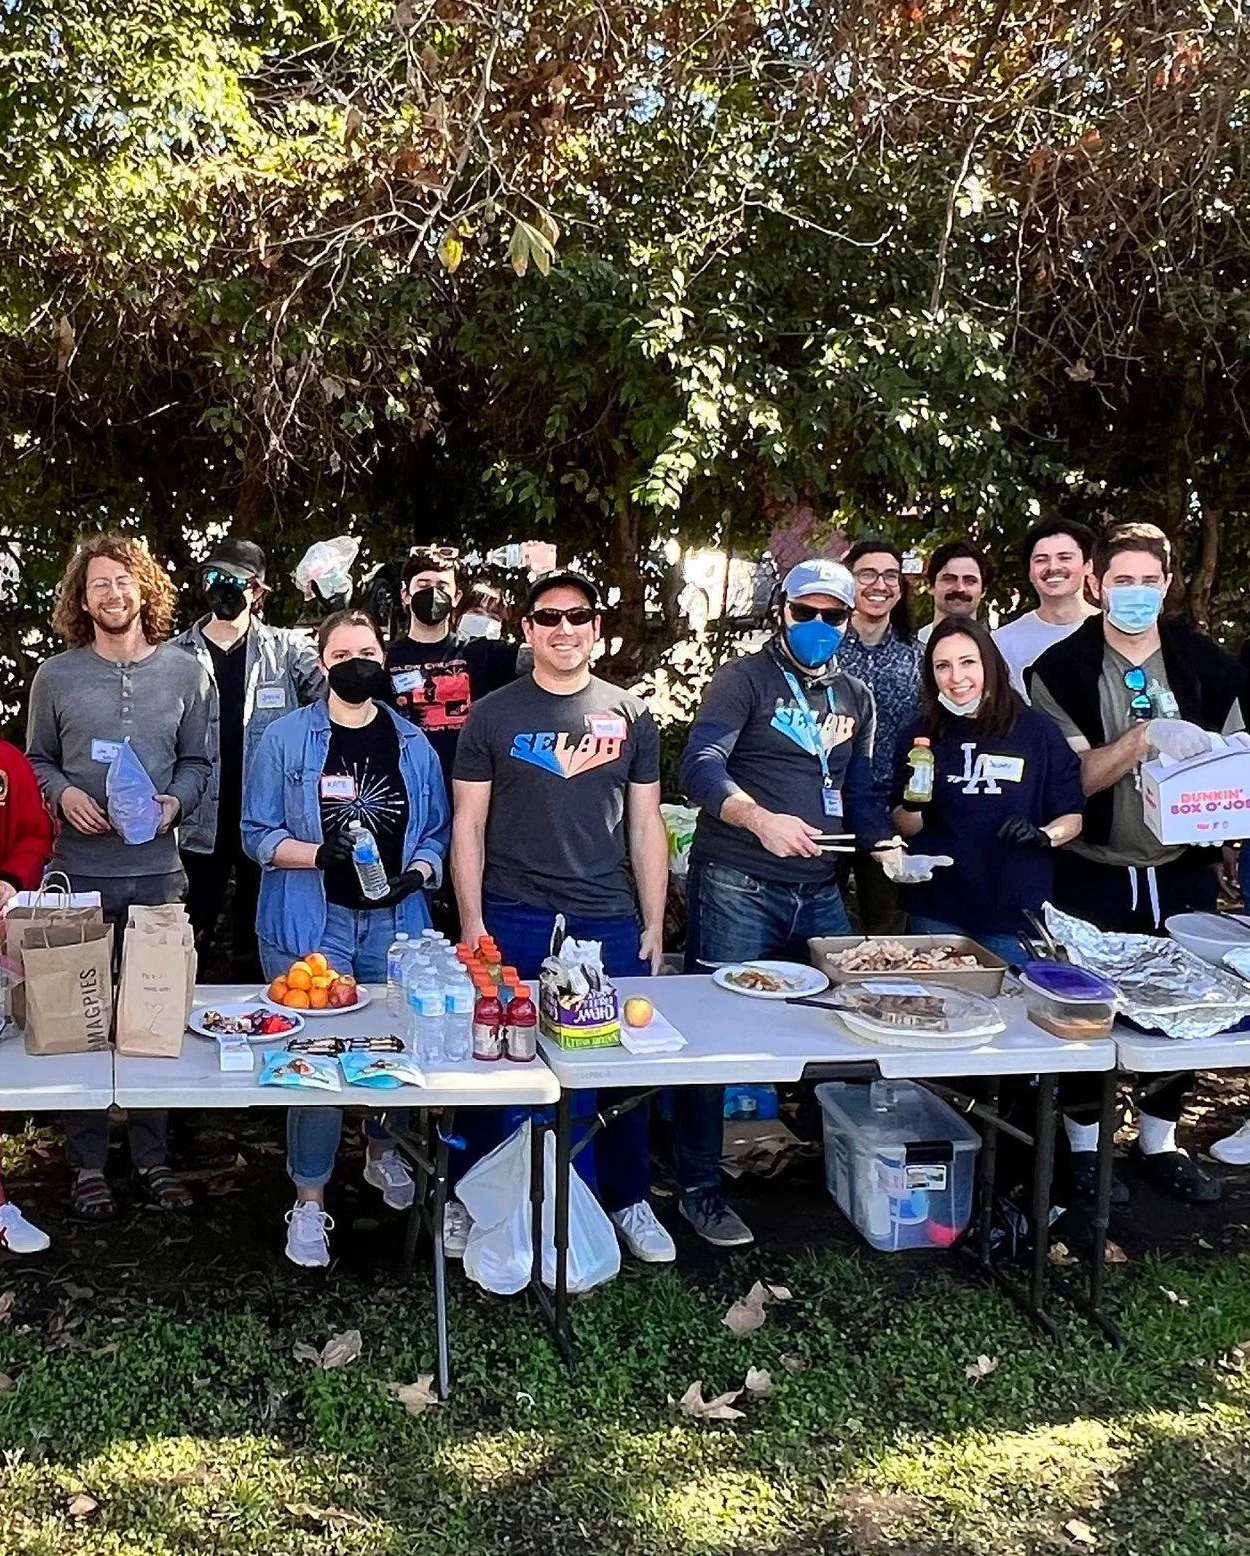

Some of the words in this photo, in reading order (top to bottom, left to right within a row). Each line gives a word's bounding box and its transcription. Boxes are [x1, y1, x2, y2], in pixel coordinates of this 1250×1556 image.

[510, 731, 622, 768] SELAH
[1181, 789, 1243, 803] DUNKIN'
[1171, 803, 1201, 814] BOX
[79, 967, 106, 1047] MAGPIES
[573, 1004, 615, 1023] CHEWY
